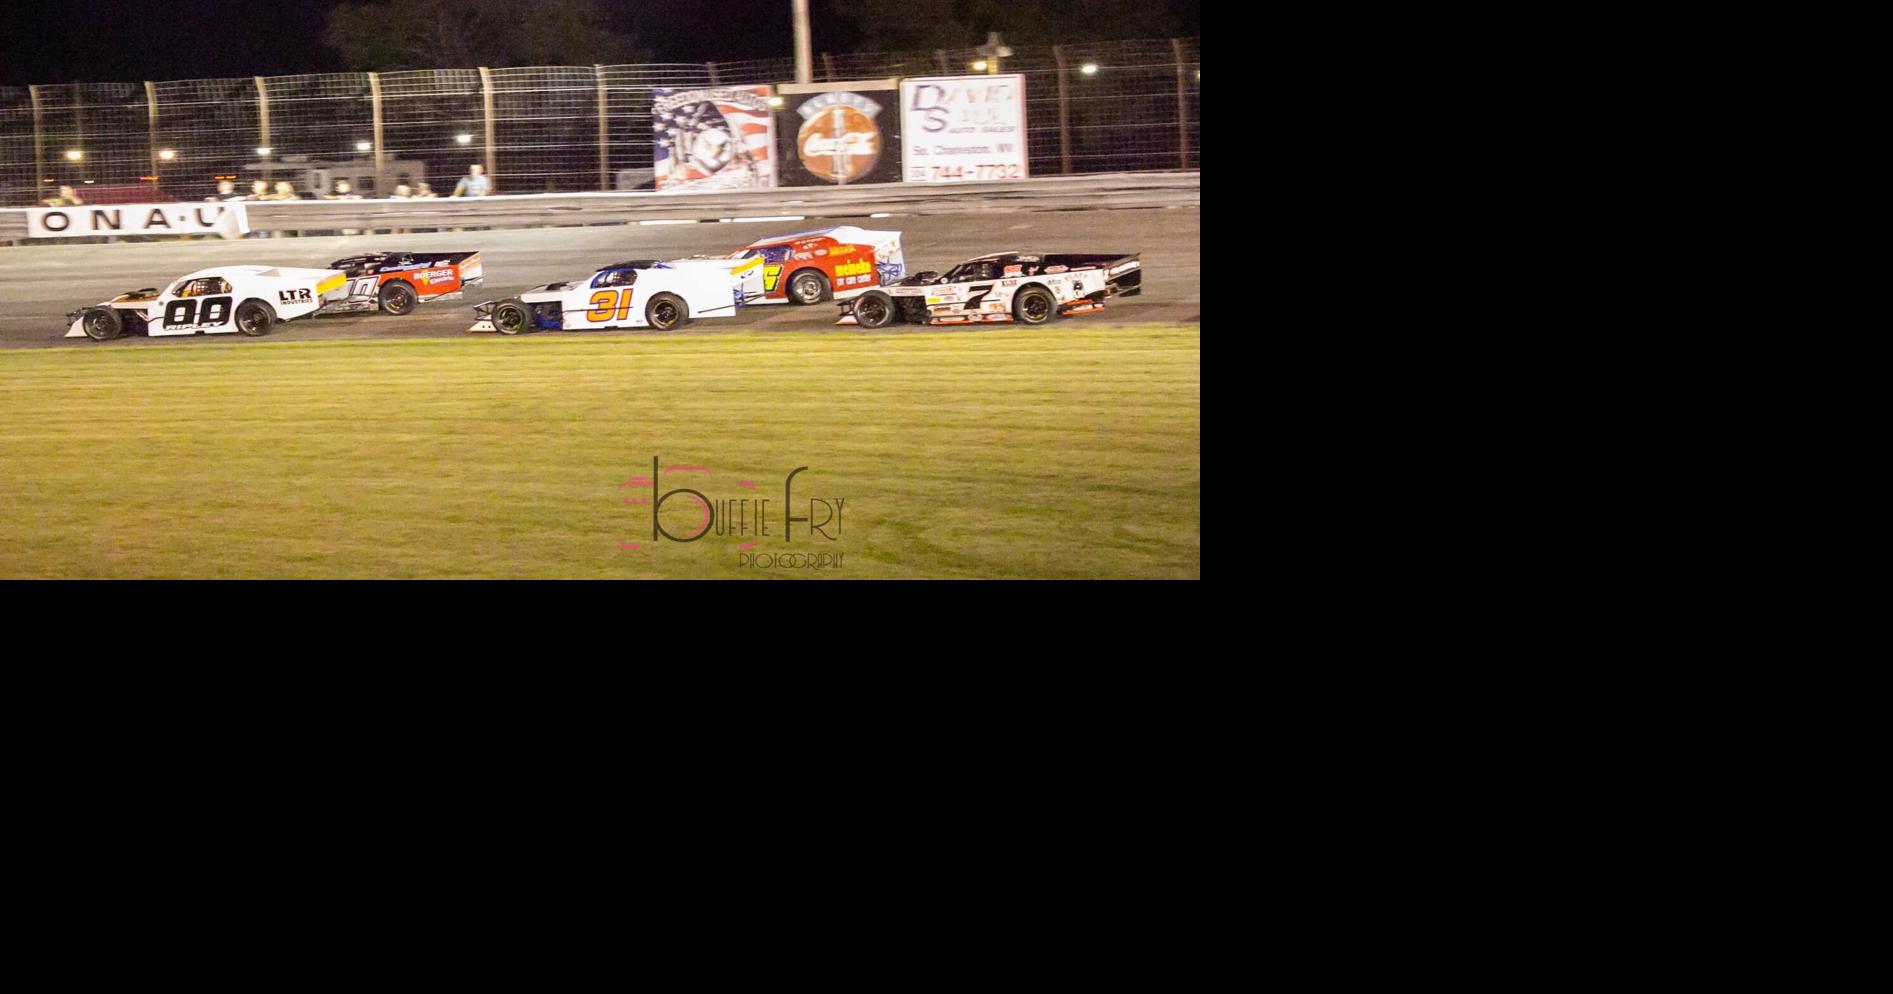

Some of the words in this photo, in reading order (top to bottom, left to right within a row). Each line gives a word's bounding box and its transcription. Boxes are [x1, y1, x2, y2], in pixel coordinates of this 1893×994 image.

[930, 163, 1020, 181] 744-7732
[278, 288, 312, 300] LTR
[586, 287, 634, 323] 31
[963, 284, 995, 310] 7
